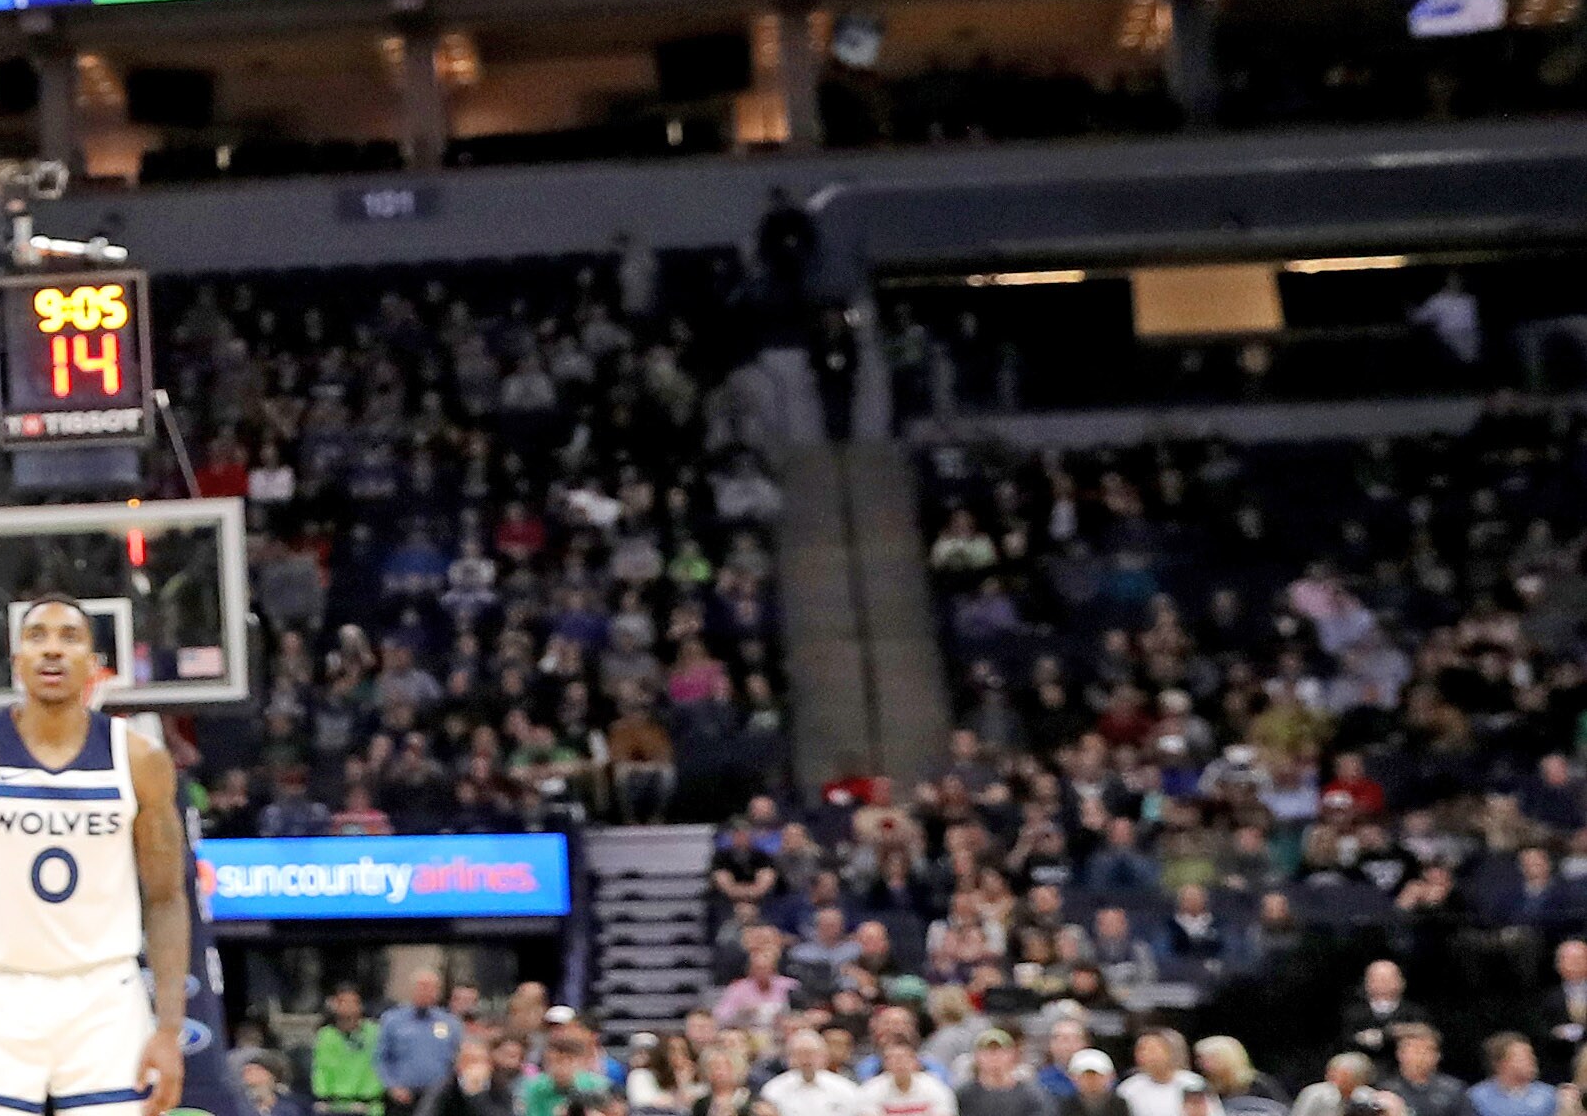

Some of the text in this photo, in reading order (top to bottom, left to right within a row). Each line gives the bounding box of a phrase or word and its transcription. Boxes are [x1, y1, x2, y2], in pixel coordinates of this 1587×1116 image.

[34, 285, 128, 333] 9:05
[51, 333, 122, 397] 14
[44, 408, 144, 437] TISSOT
[31, 847, 78, 904] 0
